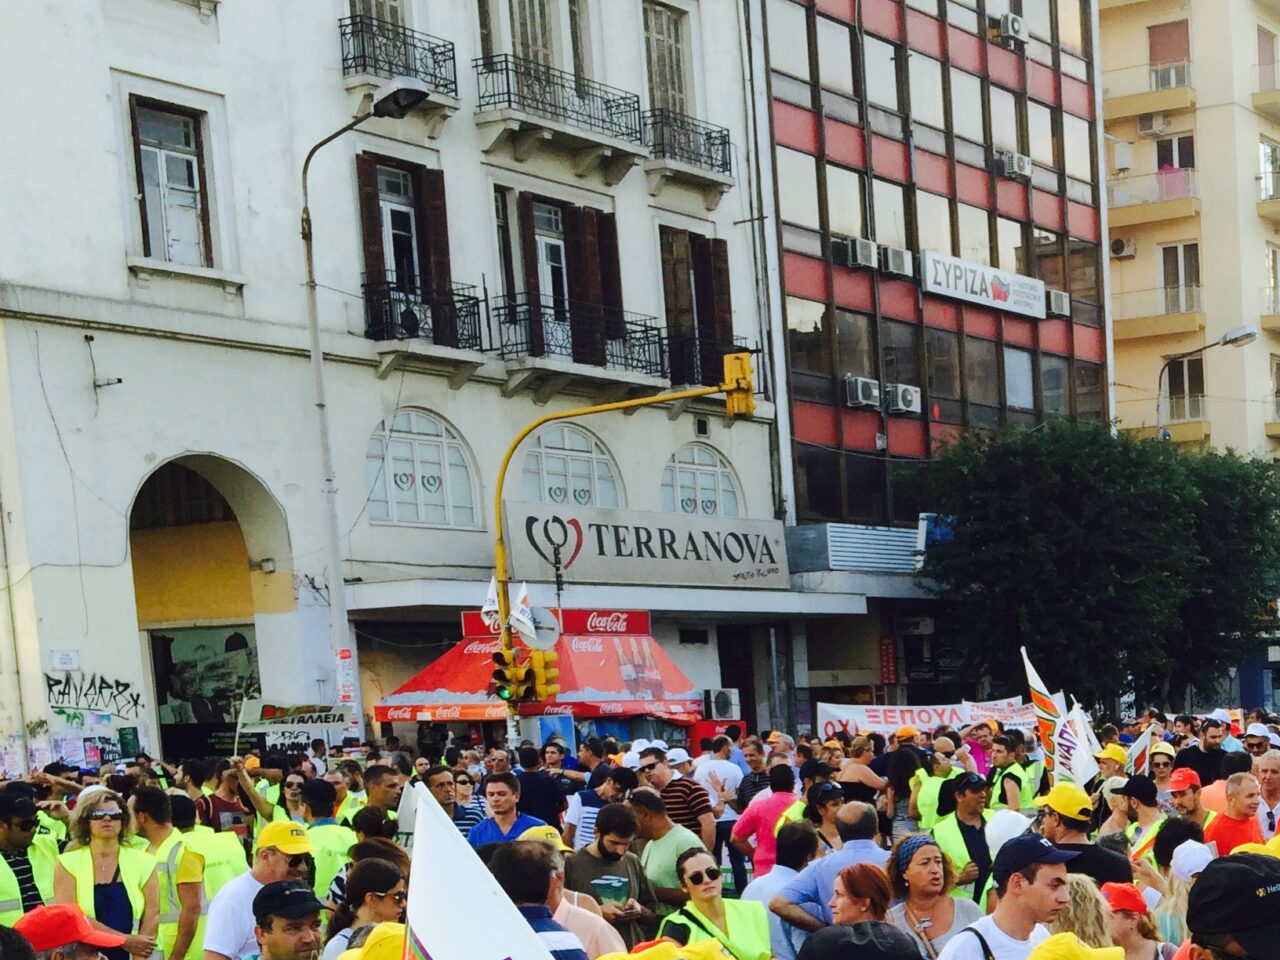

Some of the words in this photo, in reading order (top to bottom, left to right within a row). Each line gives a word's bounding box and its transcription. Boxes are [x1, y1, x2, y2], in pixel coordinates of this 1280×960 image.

[932, 258, 990, 299] ΣΥΡΙΖΑ
[588, 523, 778, 565] TERRANOVA
[586, 612, 630, 633] Coca-Cola
